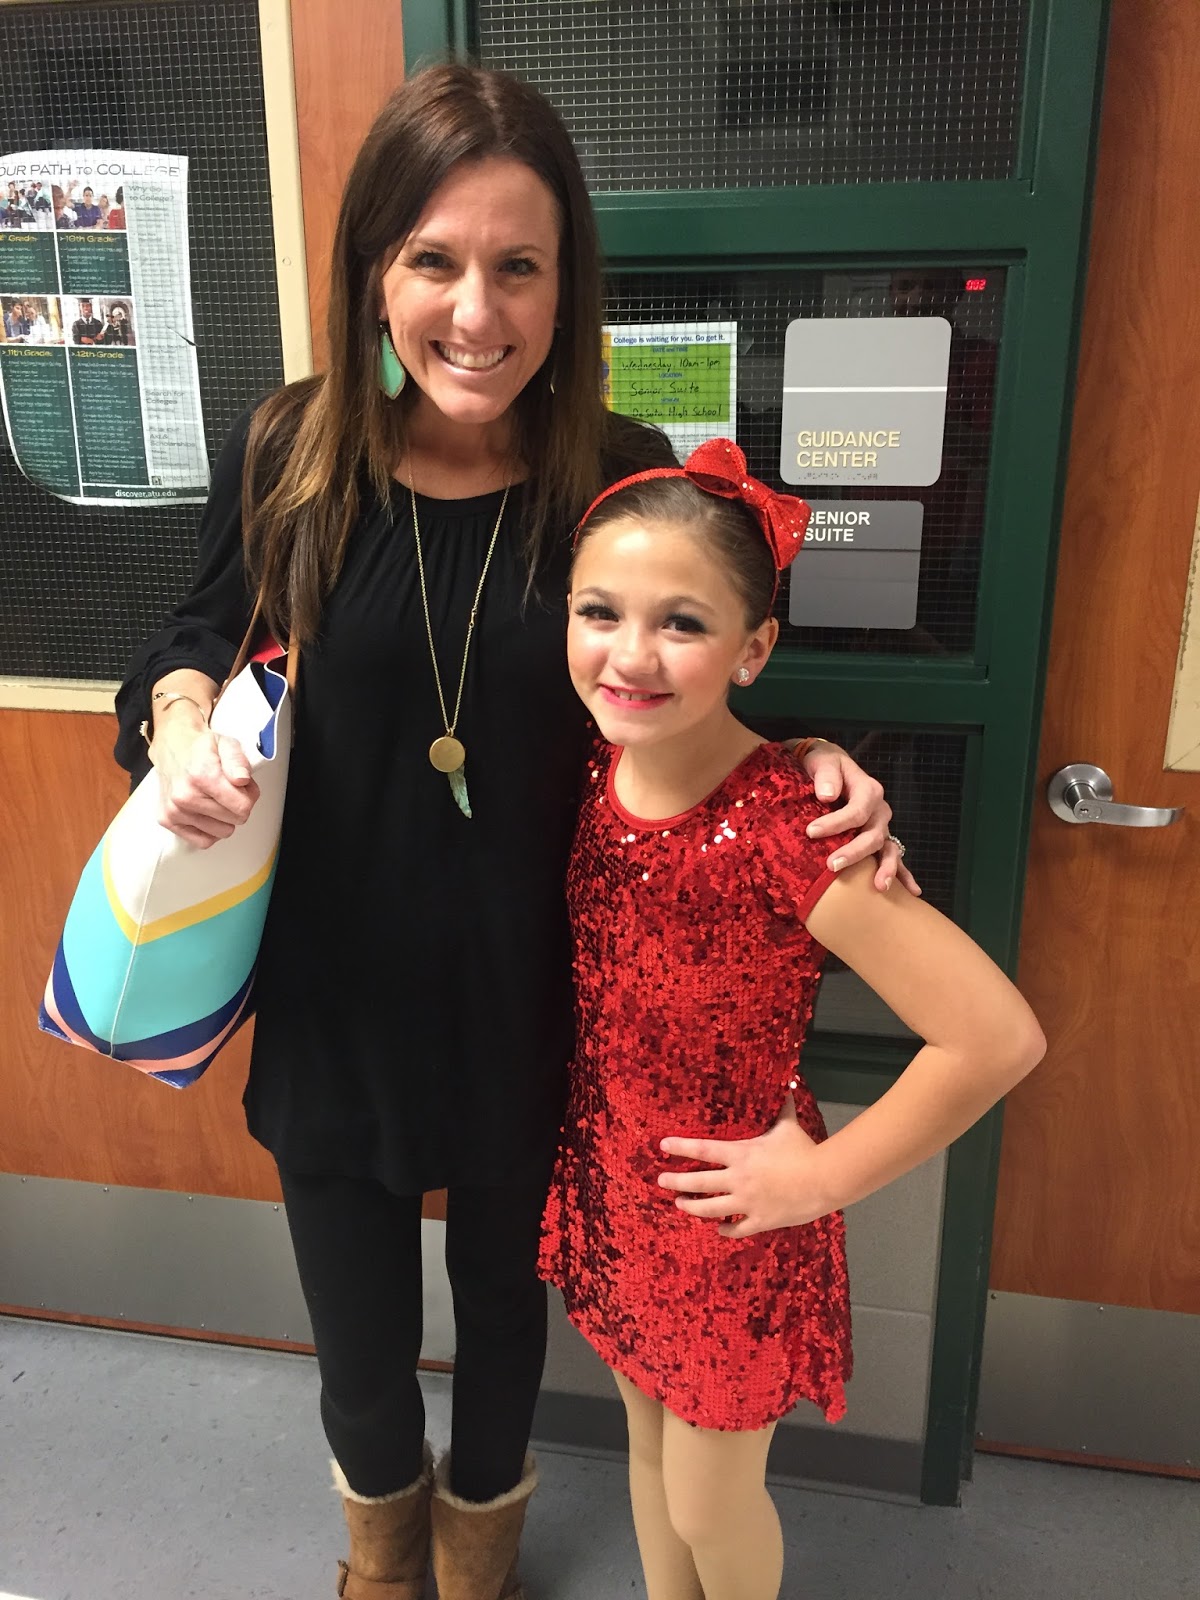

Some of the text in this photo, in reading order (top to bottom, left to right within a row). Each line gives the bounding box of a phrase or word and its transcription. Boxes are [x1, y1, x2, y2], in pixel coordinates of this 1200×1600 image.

[31, 164, 71, 176] PATH
[97, 163, 181, 178] COLLEGE
[613, 336, 637, 344] College
[646, 335, 669, 344] waiting
[797, 430, 901, 448] GUIDANCE
[796, 451, 878, 468] CENTER
[115, 488, 177, 498] discover.atu.edu
[807, 511, 870, 526] SENIOR
[804, 527, 855, 542] SUITE
